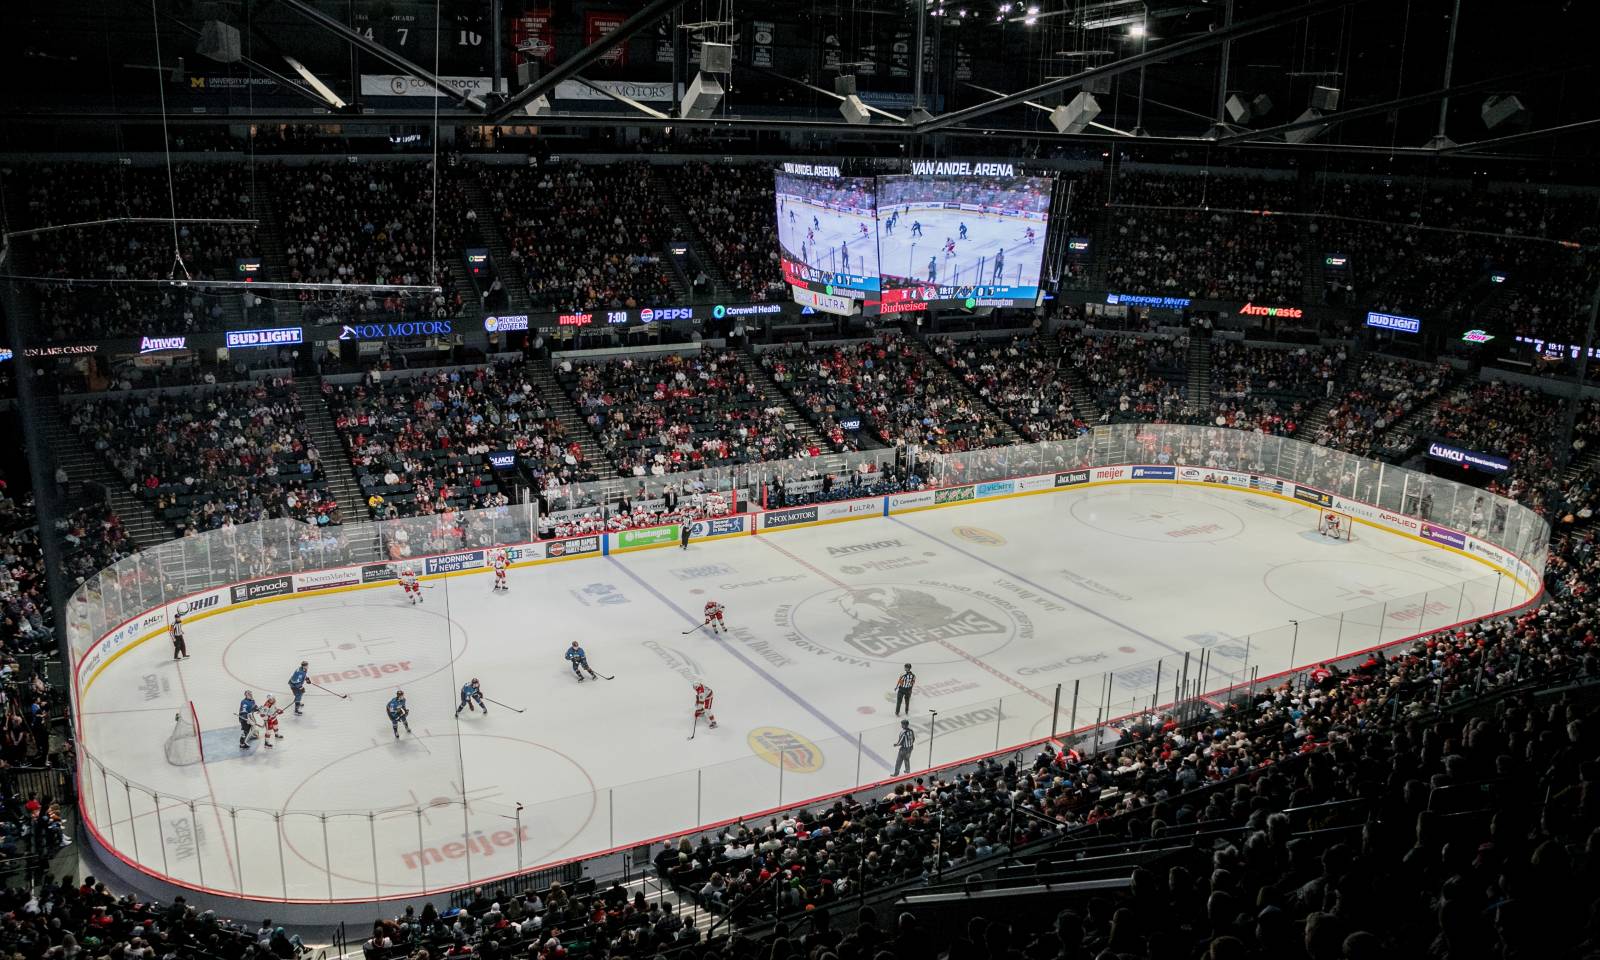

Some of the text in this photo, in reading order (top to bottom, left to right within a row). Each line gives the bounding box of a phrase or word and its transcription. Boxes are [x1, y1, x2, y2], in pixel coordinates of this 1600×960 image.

[397, 28, 409, 46] 7
[615, 86, 666, 98] MOTORS
[783, 162, 840, 178] VAN ANDEL ARENA
[912, 162, 1014, 176] VAN ANDEL ARENA
[1119, 294, 1190, 307] BRADFORD WHITE
[654, 308, 693, 320] PEPSI
[726, 304, 781, 315] Corewell Health
[880, 301, 928, 314] Budweiser
[1239, 303, 1303, 319] Arrowaste
[498, 316, 528, 324] MICHIGAN
[559, 312, 593, 327] meijer
[608, 311, 627, 323] 7:00
[1369, 313, 1418, 331] BUD LIGHT
[355, 320, 452, 339] FOX MOTORS
[499, 322, 529, 331] LOTTERY
[141, 336, 186, 350] Amway
[228, 330, 300, 345] BUD LIGHT
[40, 347, 63, 357] LAKE
[63, 345, 98, 355] CASINO
[1438, 447, 1465, 461] LMCU
[1057, 475, 1070, 484] JACK
[1096, 468, 1124, 480] meijer
[853, 503, 875, 512] ULTRA
[774, 515, 787, 523] FOX
[787, 511, 816, 521] MOTORS
[1378, 512, 1417, 529] APPLIED
[635, 527, 671, 540] Huntington
[826, 539, 902, 555] Amway
[438, 553, 474, 565] MORNING
[430, 562, 460, 572] 17 NEWS
[858, 611, 995, 655] GRIFFINS
[832, 655, 872, 668] VAN
[311, 660, 411, 685] meijer
[401, 825, 528, 870] meijer
